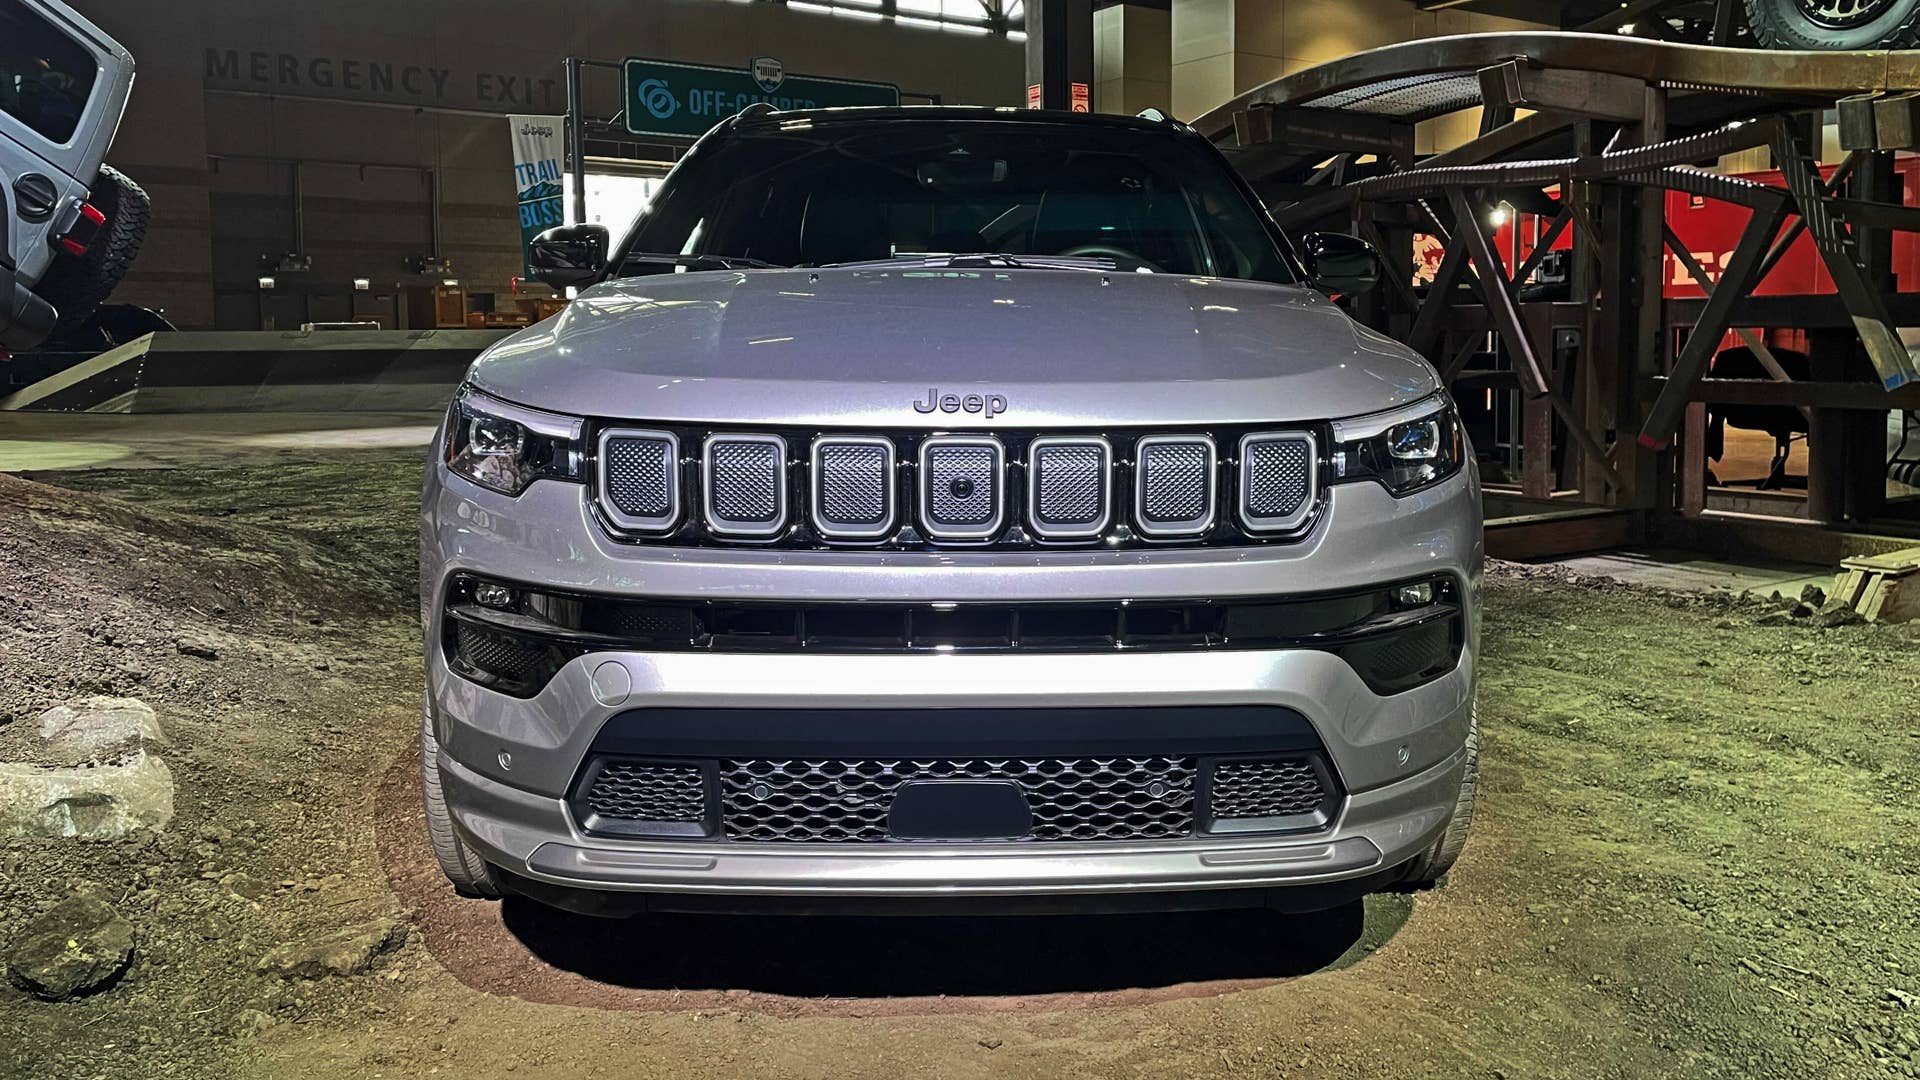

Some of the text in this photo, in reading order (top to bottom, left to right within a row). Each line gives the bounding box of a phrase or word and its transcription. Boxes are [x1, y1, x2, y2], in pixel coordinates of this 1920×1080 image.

[475, 73, 555, 105] EXIT
[521, 124, 553, 138] Jeep
[516, 159, 563, 186] TRAIL
[519, 199, 563, 229] BOSS
[913, 387, 1008, 419] Jeep
